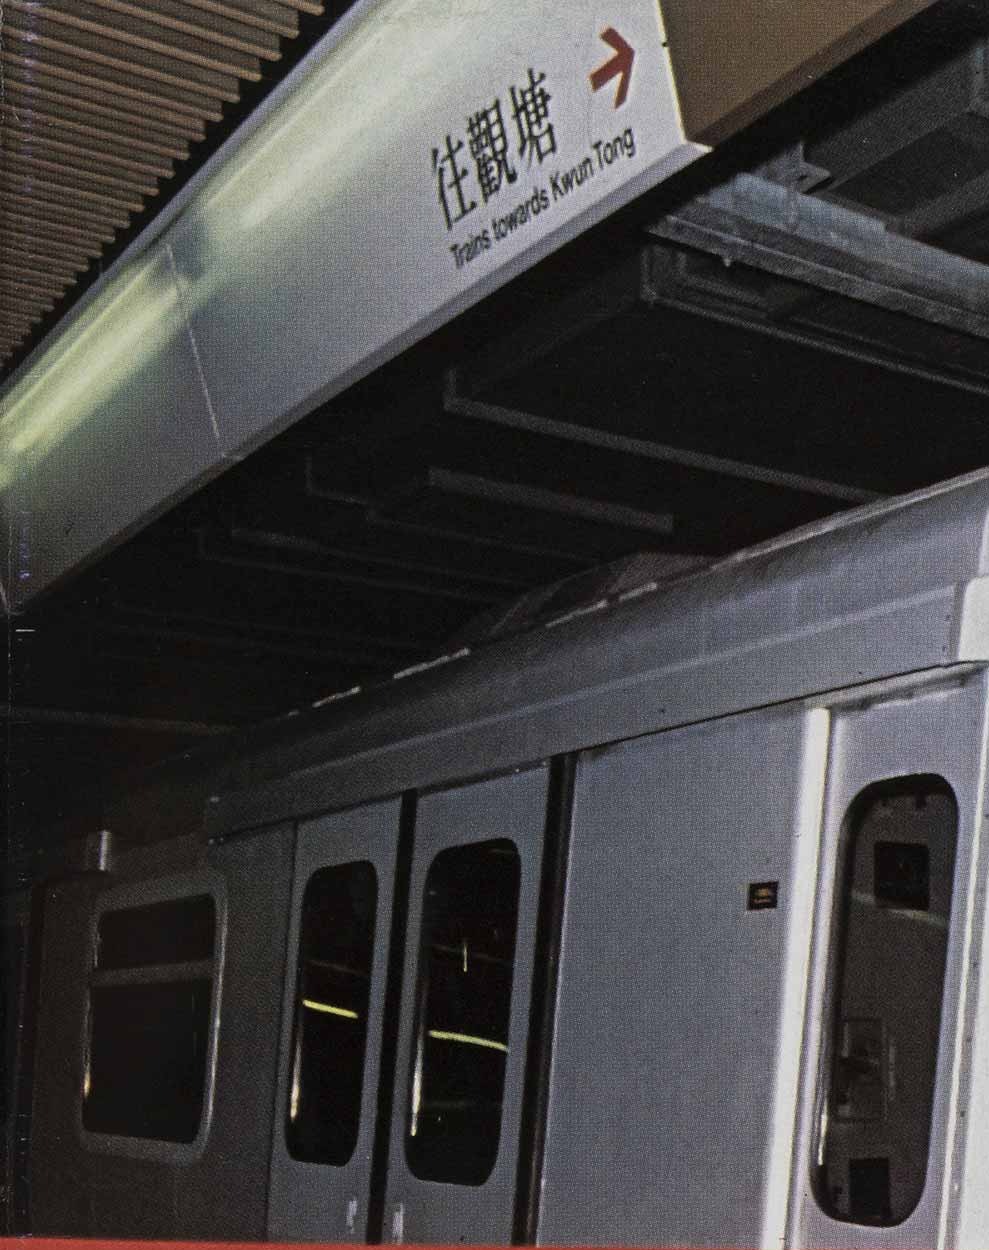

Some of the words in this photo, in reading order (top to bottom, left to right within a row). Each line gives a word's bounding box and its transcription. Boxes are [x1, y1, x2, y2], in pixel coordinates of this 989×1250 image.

[449, 229, 491, 269] Trains
[491, 186, 550, 241] towards
[550, 157, 594, 200] Kwun
[591, 128, 636, 170] Tong
